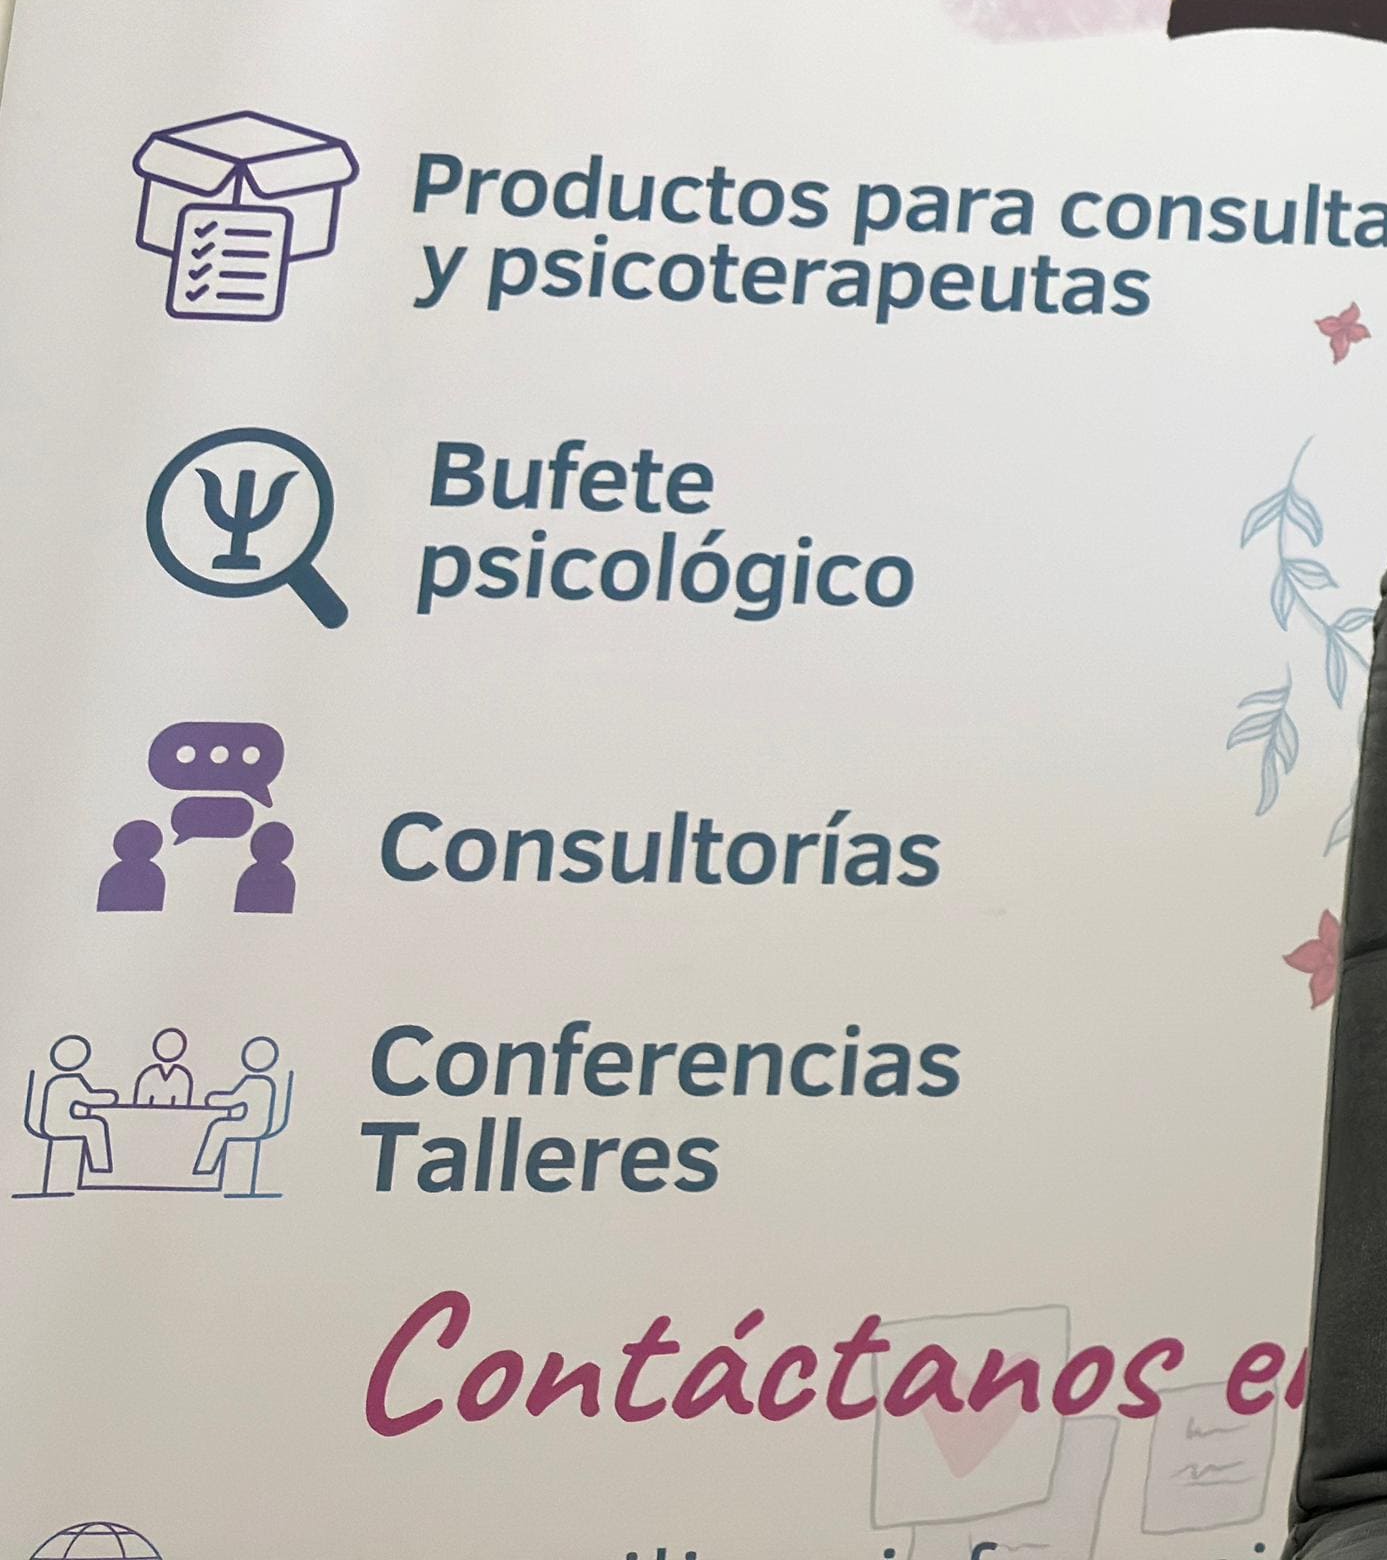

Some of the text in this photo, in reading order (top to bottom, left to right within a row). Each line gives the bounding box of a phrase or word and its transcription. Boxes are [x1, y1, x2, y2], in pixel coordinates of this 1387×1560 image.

[411, 151, 830, 230] Productos
[852, 177, 1035, 242] para
[411, 237, 1152, 323] y psicoterapeutas
[429, 440, 716, 517] Bufete
[416, 530, 915, 621] psicológico
[381, 810, 941, 887] Consultorías
[370, 1020, 960, 1097] Conferencias
[360, 1118, 719, 1194] Talleres
[365, 1289, 1185, 1437] Contáctanos
